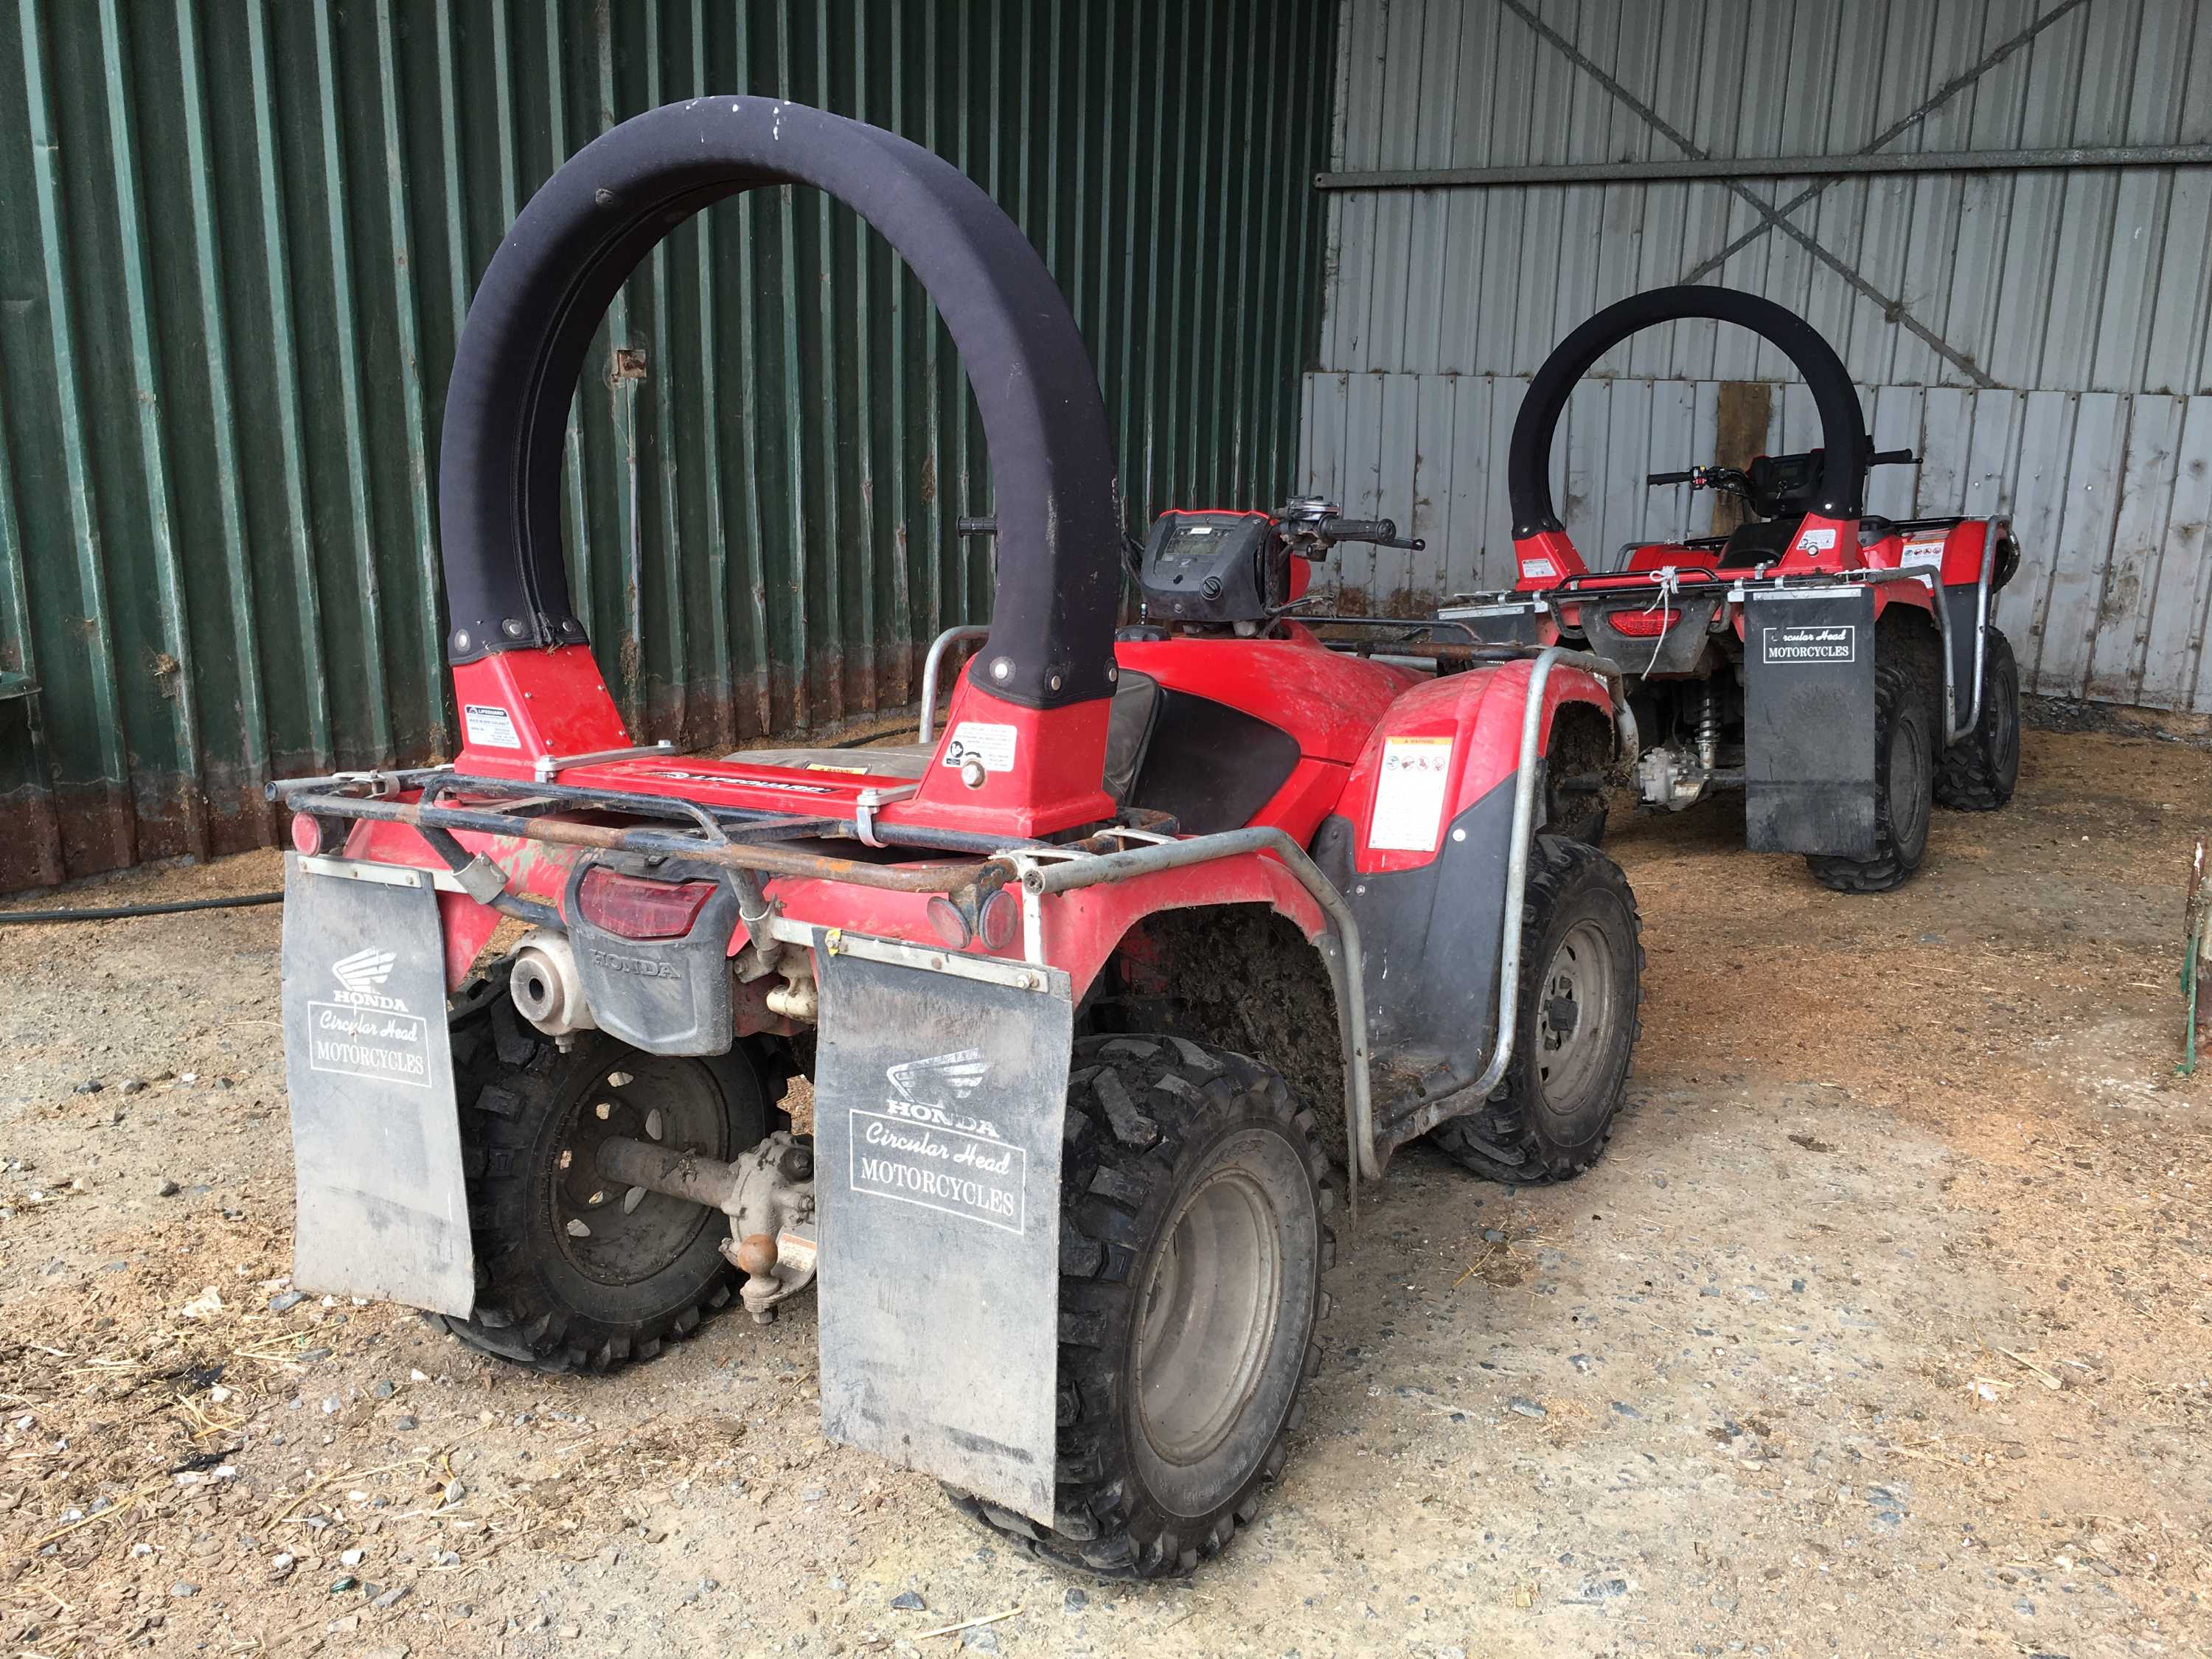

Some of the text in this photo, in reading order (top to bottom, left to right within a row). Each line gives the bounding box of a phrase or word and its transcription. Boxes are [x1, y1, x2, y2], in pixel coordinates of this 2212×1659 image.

[1771, 629, 1846, 641] rcular Head
[1768, 645, 1849, 658] MOTORCYCLES
[589, 948, 681, 978] HONDA
[333, 990, 408, 1012] HONDA
[320, 1010, 418, 1042] Circular Head
[317, 1041, 424, 1075] MOTORCYCLES
[886, 1099, 1000, 1138] HONDA
[866, 1122, 1011, 1175] Circular Head
[861, 1157, 1014, 1217] MOTORCYCLES
